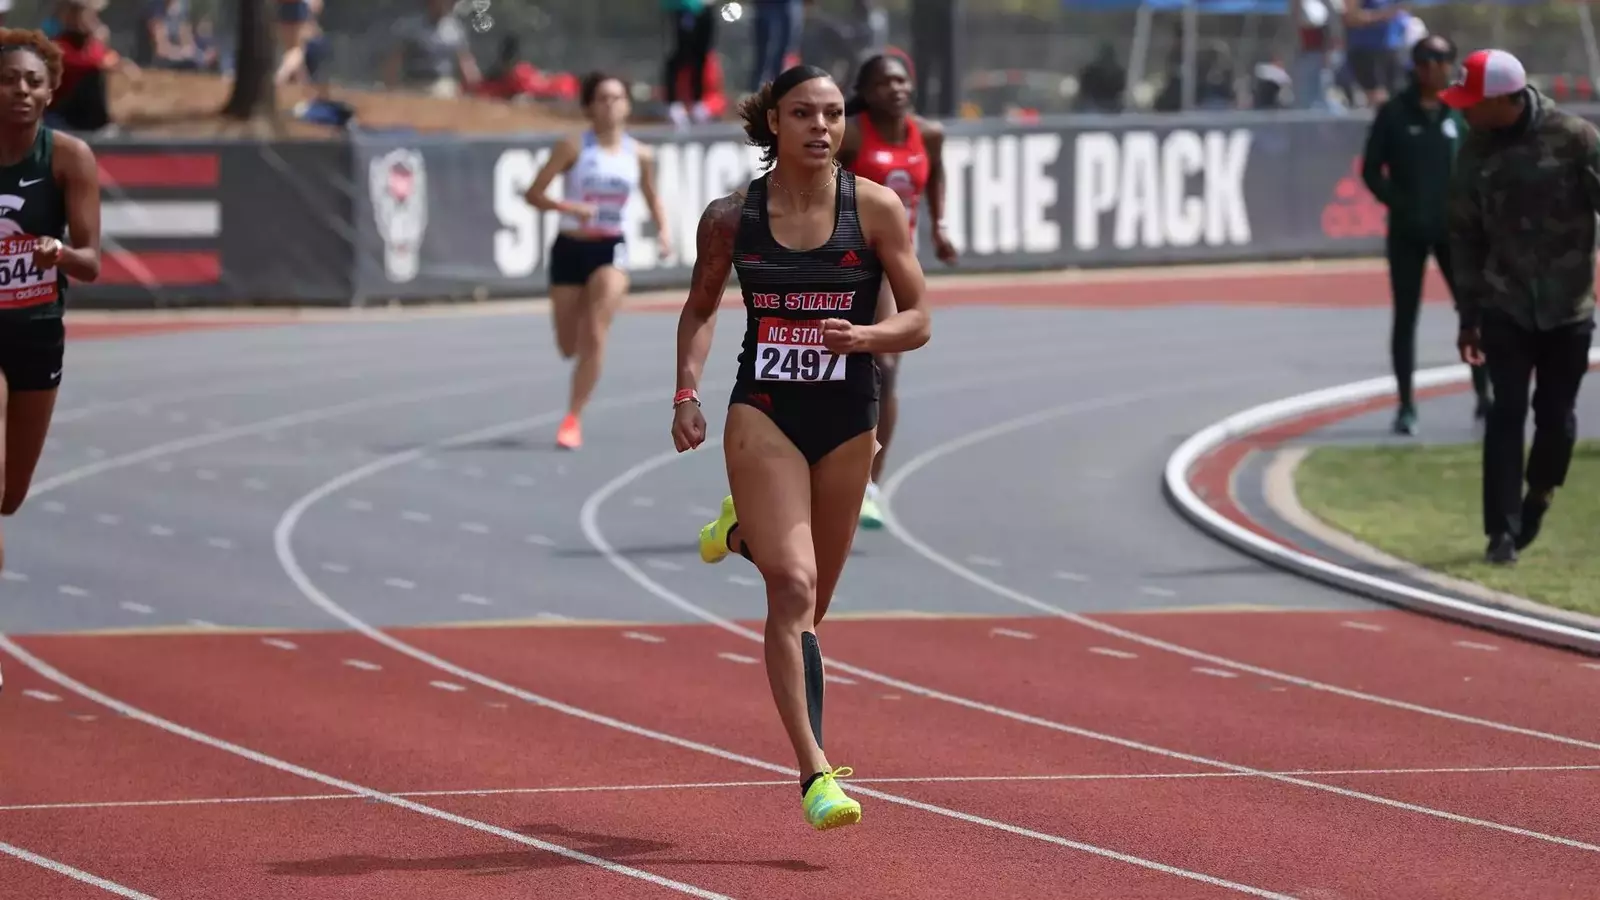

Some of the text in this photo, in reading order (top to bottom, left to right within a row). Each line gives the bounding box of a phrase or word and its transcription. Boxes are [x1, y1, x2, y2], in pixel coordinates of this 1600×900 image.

[942, 133, 1062, 253] THE
[1073, 128, 1254, 250] PACK
[15, 283, 53, 300] adidas
[753, 291, 856, 311] NC STATE
[768, 326, 788, 342] NC
[760, 347, 840, 380] 2497
